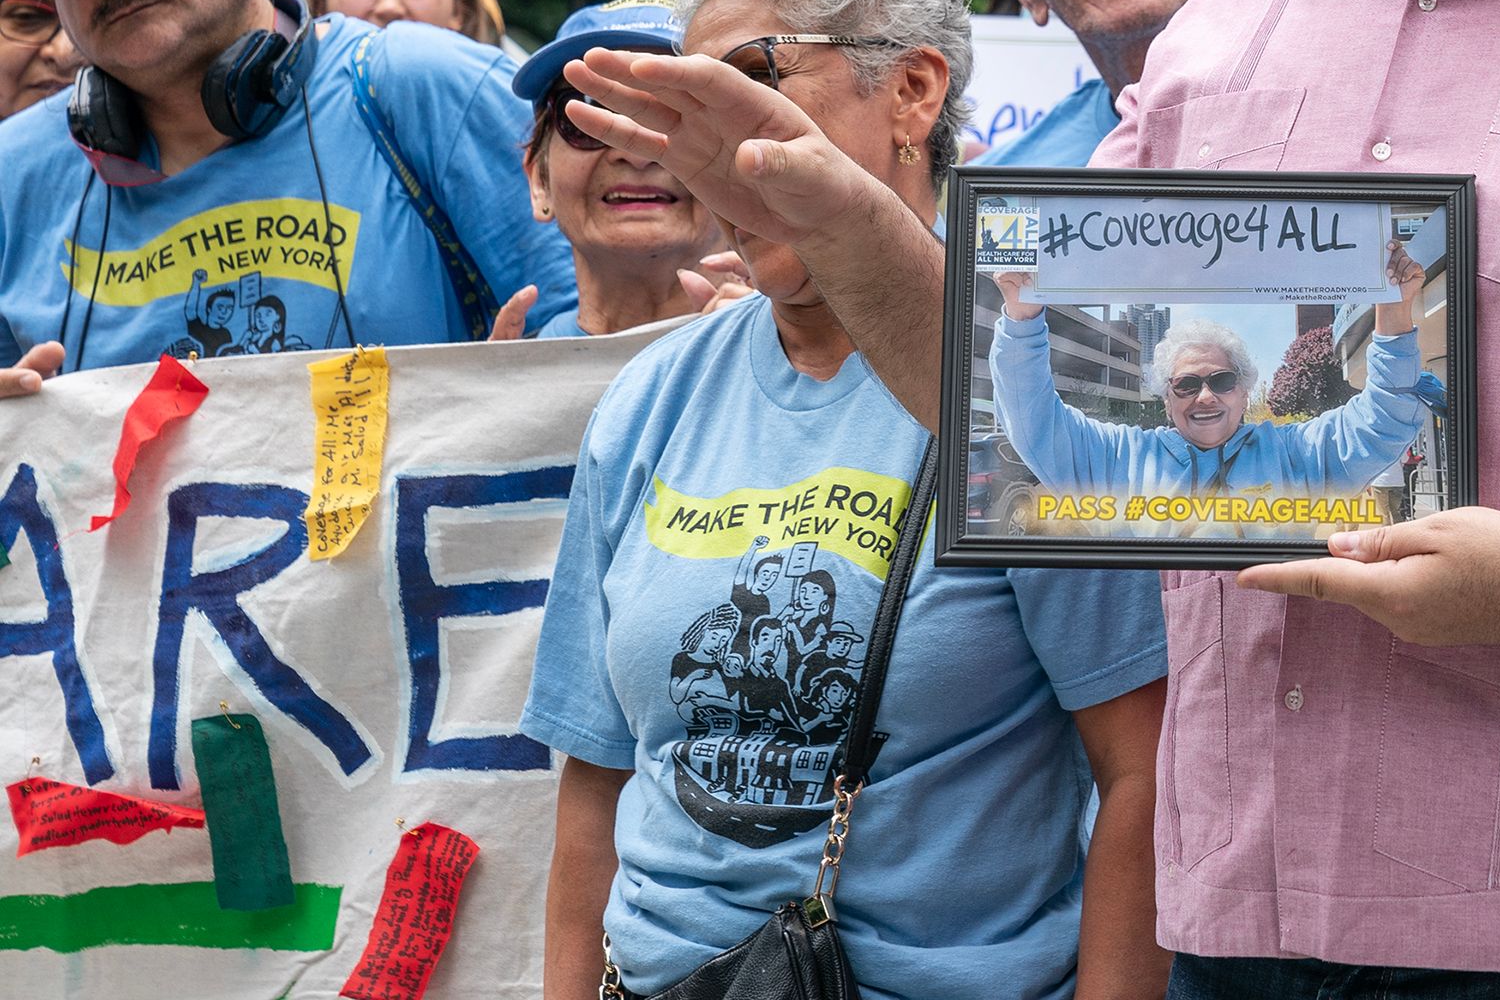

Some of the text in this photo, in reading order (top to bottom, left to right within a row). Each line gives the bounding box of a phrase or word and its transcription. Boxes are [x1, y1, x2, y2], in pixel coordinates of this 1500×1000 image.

[999, 216, 1022, 249] 4
[1025, 216, 1038, 249] ALL
[105, 214, 347, 286] MAKE THE ROAD
[218, 246, 341, 276] NEW YORK
[666, 503, 749, 534] MAKE
[758, 485, 820, 525] THE
[1038, 495, 1384, 524] PASS #COVERAGE4ALL
[781, 516, 894, 562] NEW YOR
